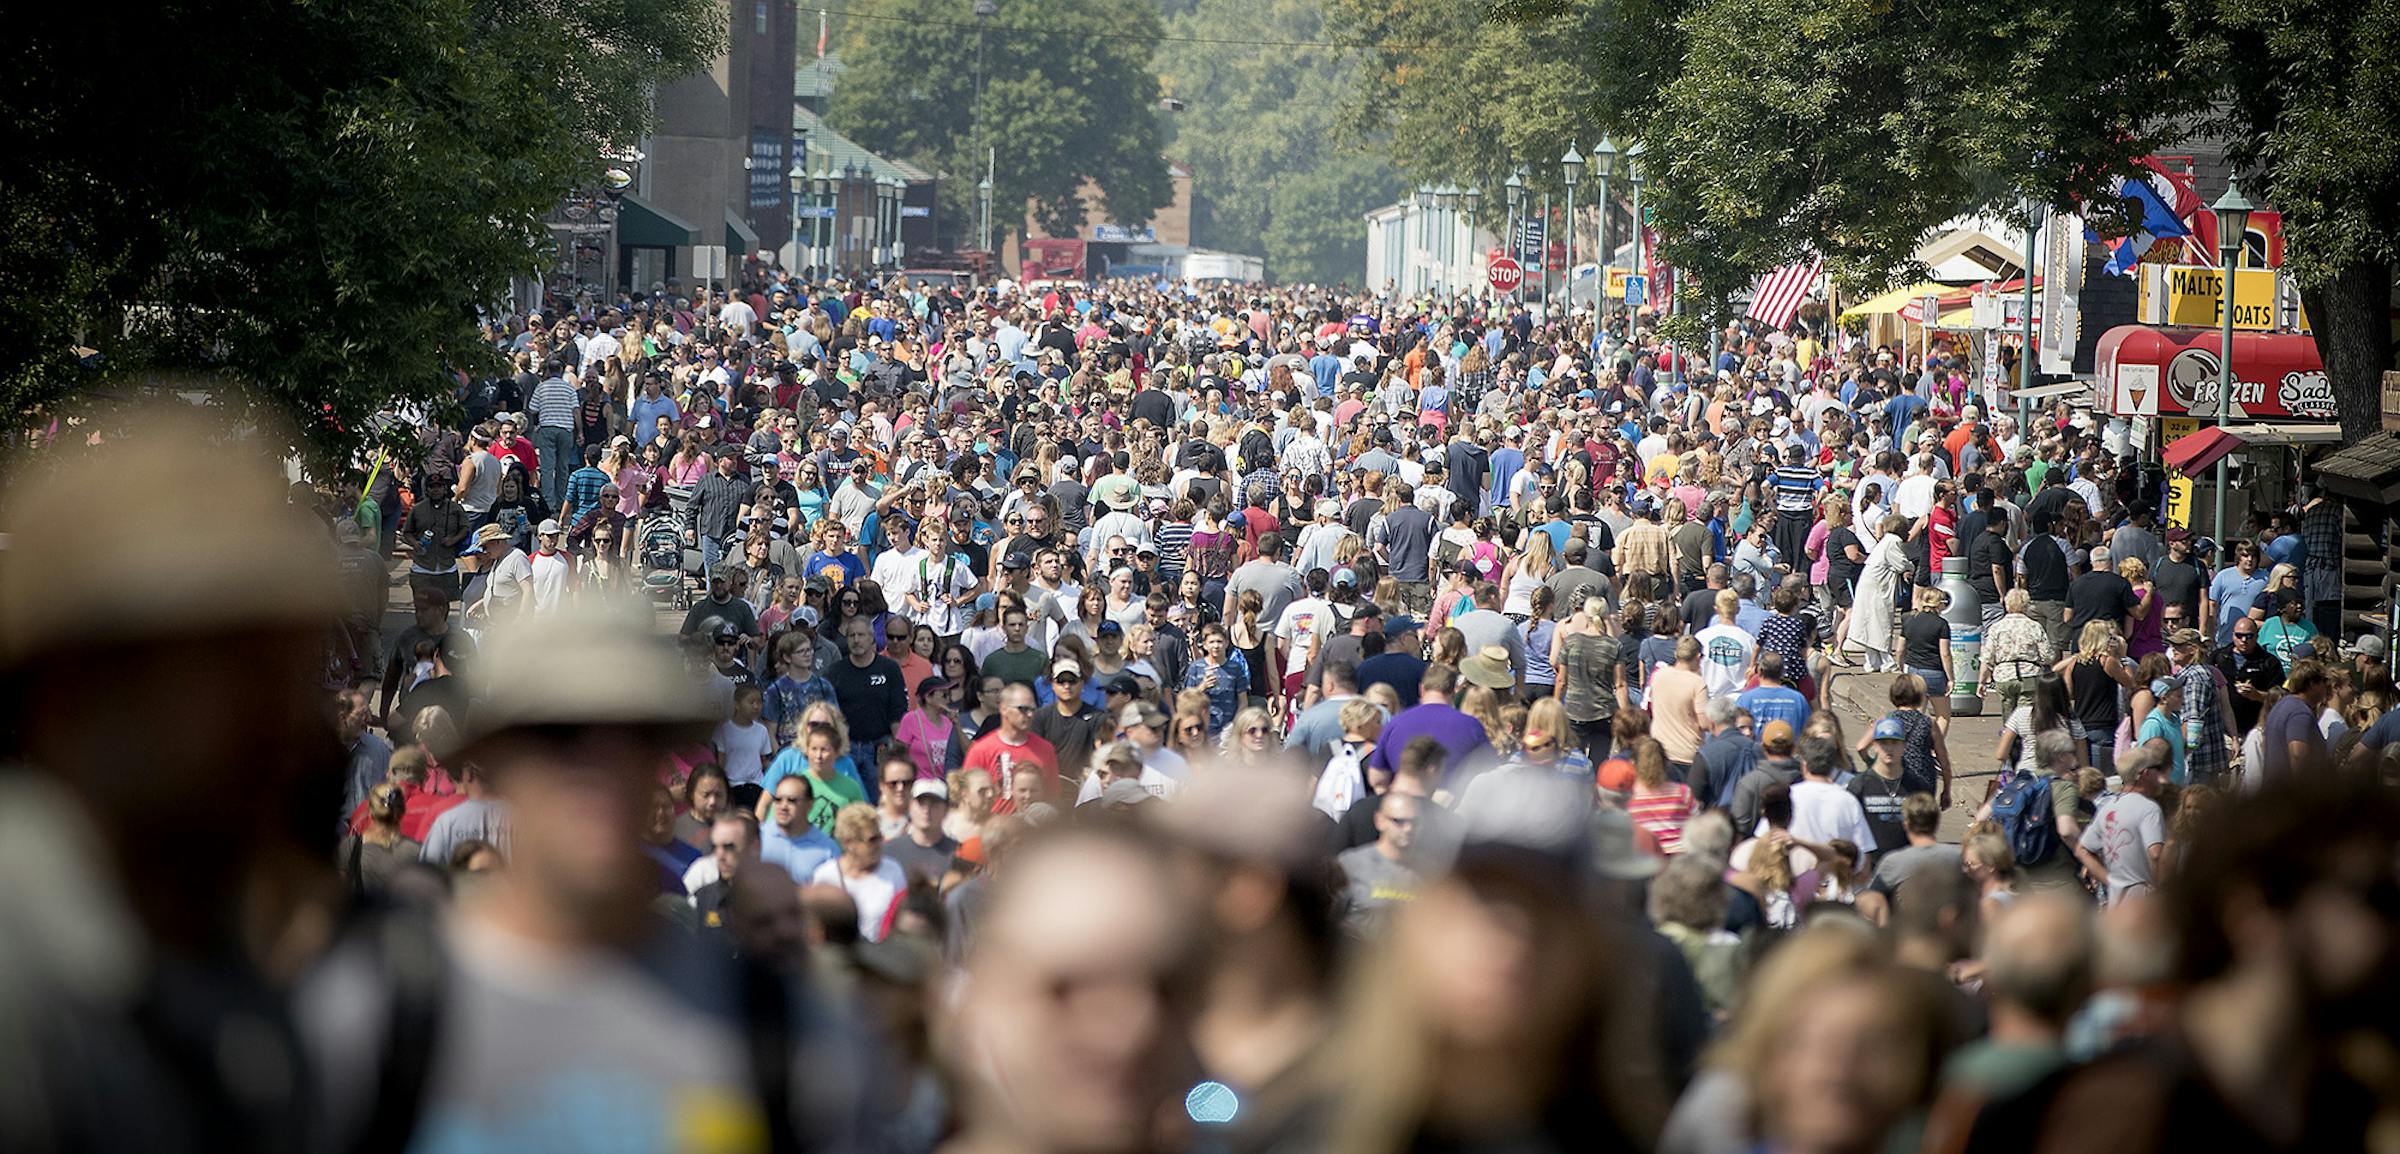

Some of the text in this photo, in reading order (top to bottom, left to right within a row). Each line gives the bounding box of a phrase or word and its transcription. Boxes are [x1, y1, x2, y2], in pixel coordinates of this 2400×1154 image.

[1489, 266, 1520, 283] STOP
[2172, 270, 2223, 297] MALTS
[2214, 299, 2271, 326] FOATS
[2194, 380, 2266, 404] FRZEN
